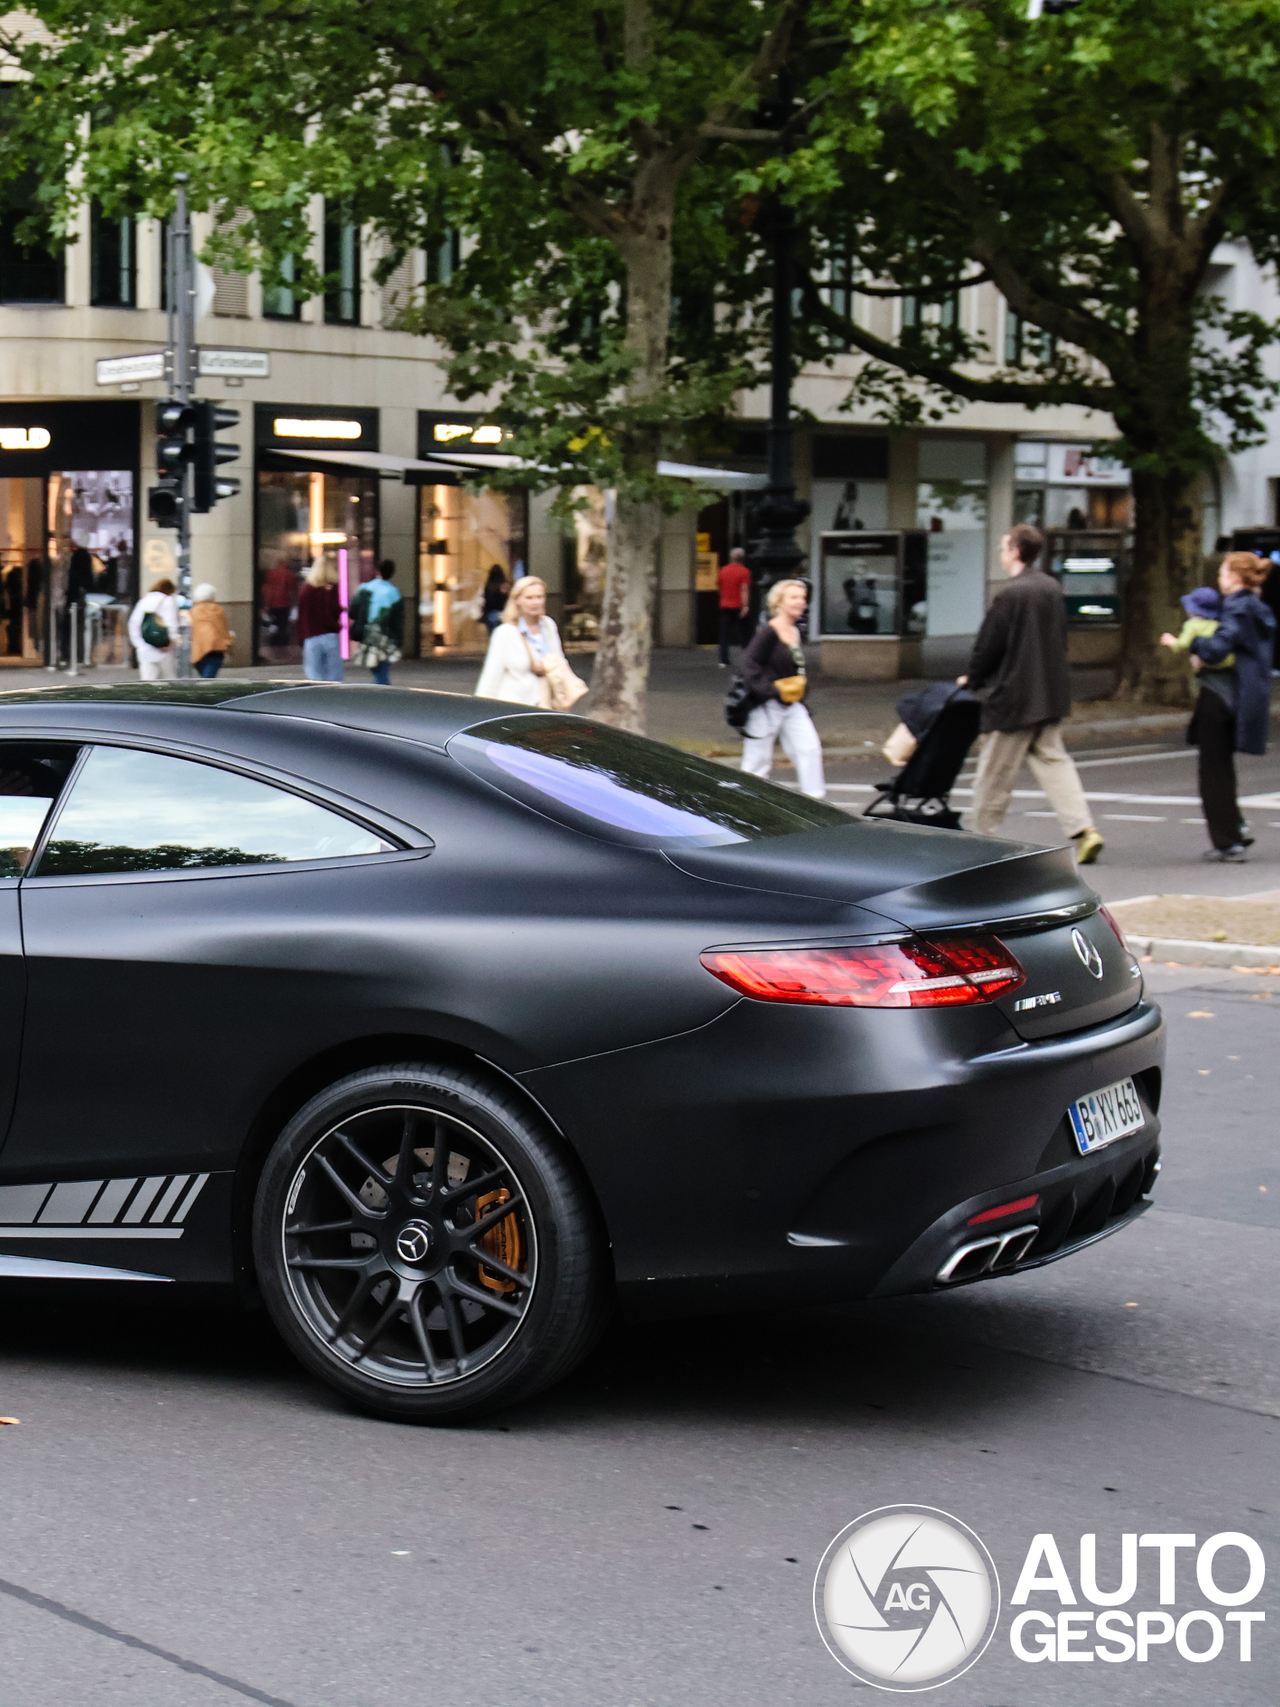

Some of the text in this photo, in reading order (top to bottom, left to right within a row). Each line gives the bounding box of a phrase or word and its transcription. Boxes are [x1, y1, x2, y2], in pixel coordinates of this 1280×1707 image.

[392, 1081, 460, 1101] POTENZA
[1079, 1082, 1141, 1142] B XY 663
